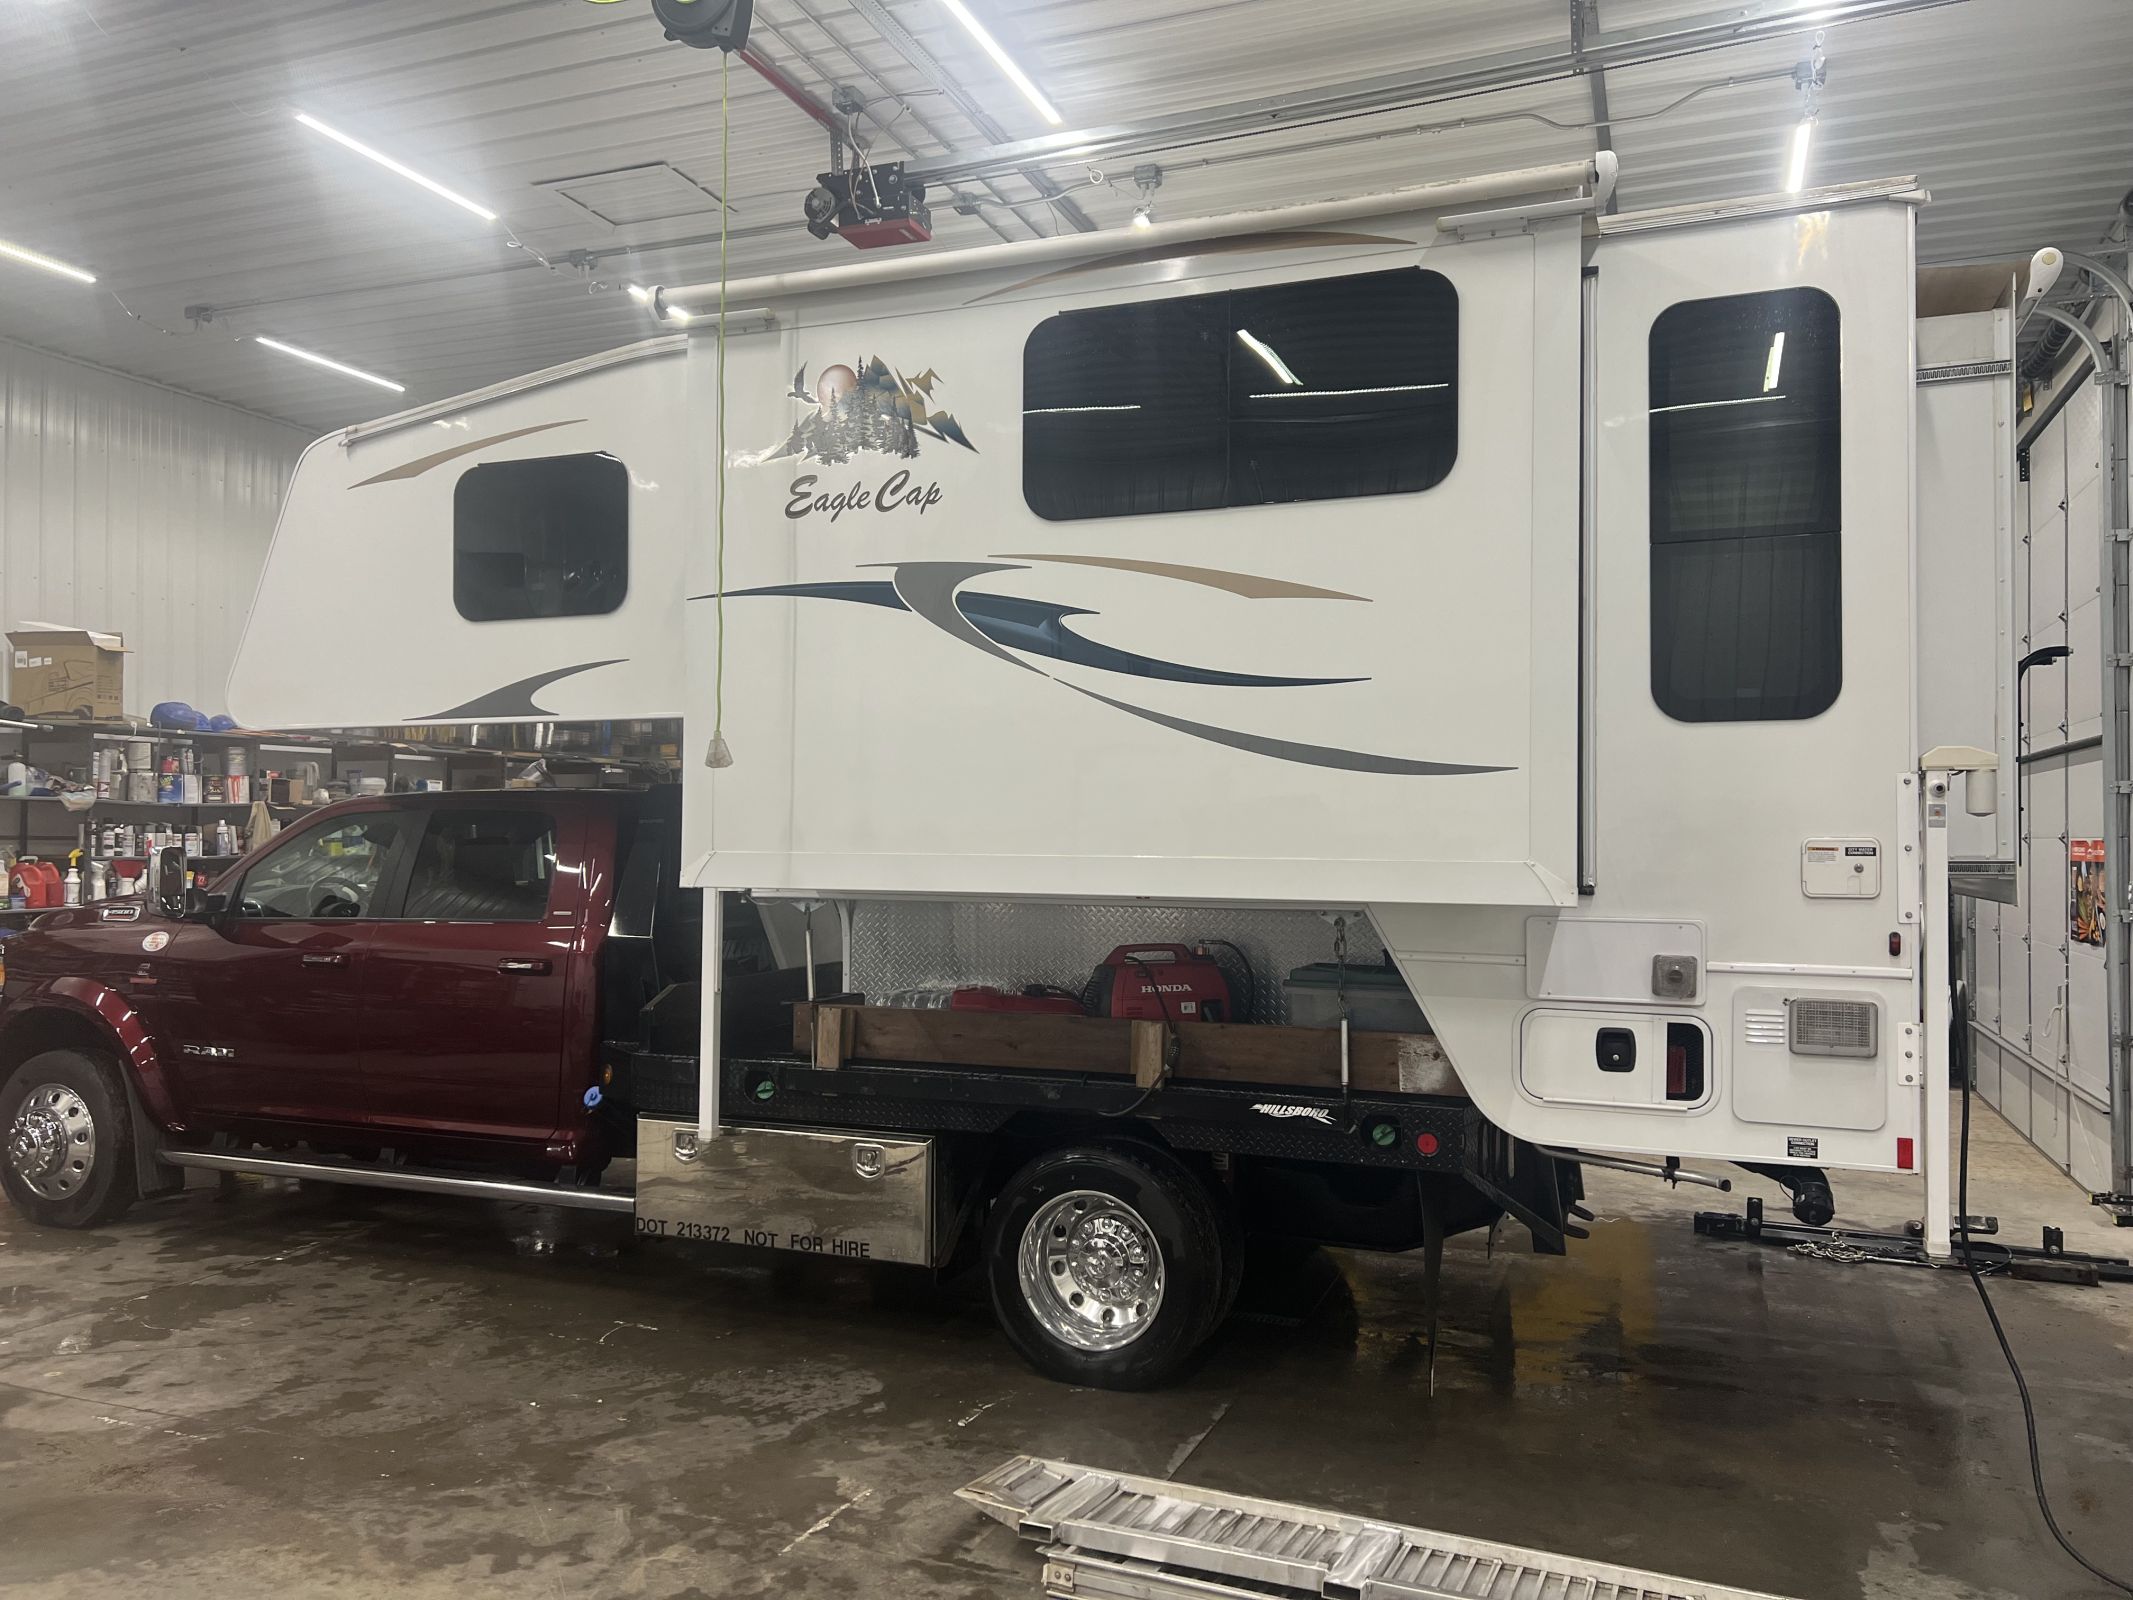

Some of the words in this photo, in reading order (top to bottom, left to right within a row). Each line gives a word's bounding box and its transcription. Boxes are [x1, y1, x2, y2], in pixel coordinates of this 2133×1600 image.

[784, 474, 871, 523] Eagle
[874, 469, 943, 515] Cap
[1141, 983, 1193, 993] HONDA
[183, 1044, 235, 1058] RAM
[1256, 1103, 1331, 1119] HILLSBORO
[636, 1217, 668, 1235] DOT
[677, 1222, 730, 1242] 213372
[744, 1230, 778, 1248] NOT
[790, 1234, 824, 1252] FOR
[832, 1239, 870, 1258] HIRE
